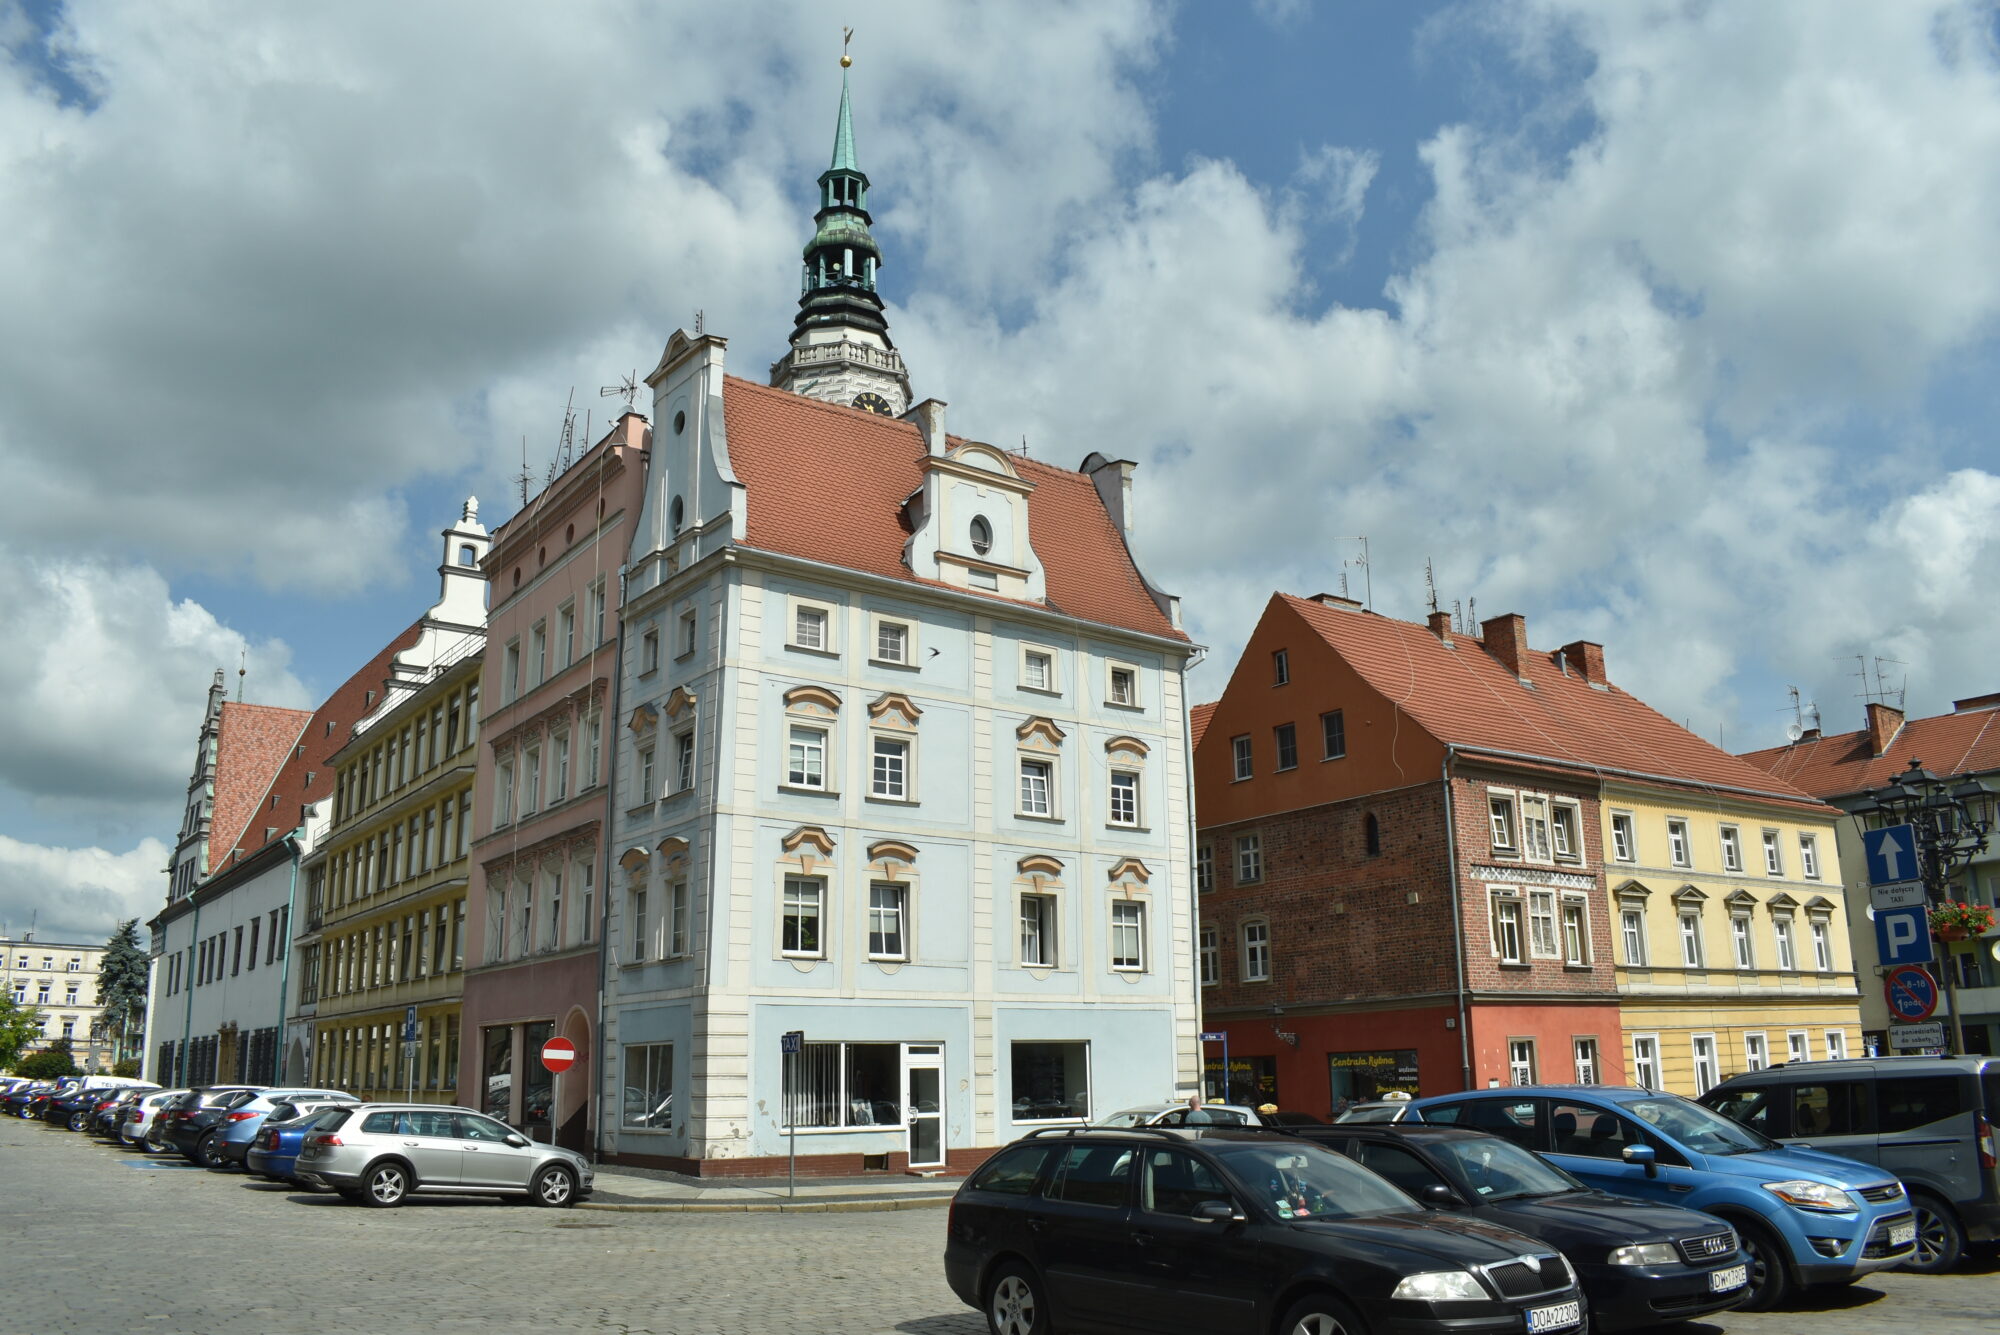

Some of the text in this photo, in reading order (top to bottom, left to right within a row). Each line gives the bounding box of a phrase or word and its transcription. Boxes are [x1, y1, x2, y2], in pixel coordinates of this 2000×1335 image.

[1891, 886, 1914, 895] dotyczy
[1885, 913, 1917, 958] P
[1897, 999, 1903, 1012] 1
[408, 1009, 414, 1030] P
[783, 1036, 799, 1051] TAXI
[1332, 1055, 1396, 1068] Centrala Rybna
[1714, 1271, 1726, 1288] DW
[1532, 1309, 1552, 1328] DOA
[1553, 1303, 1579, 1324] 22308
